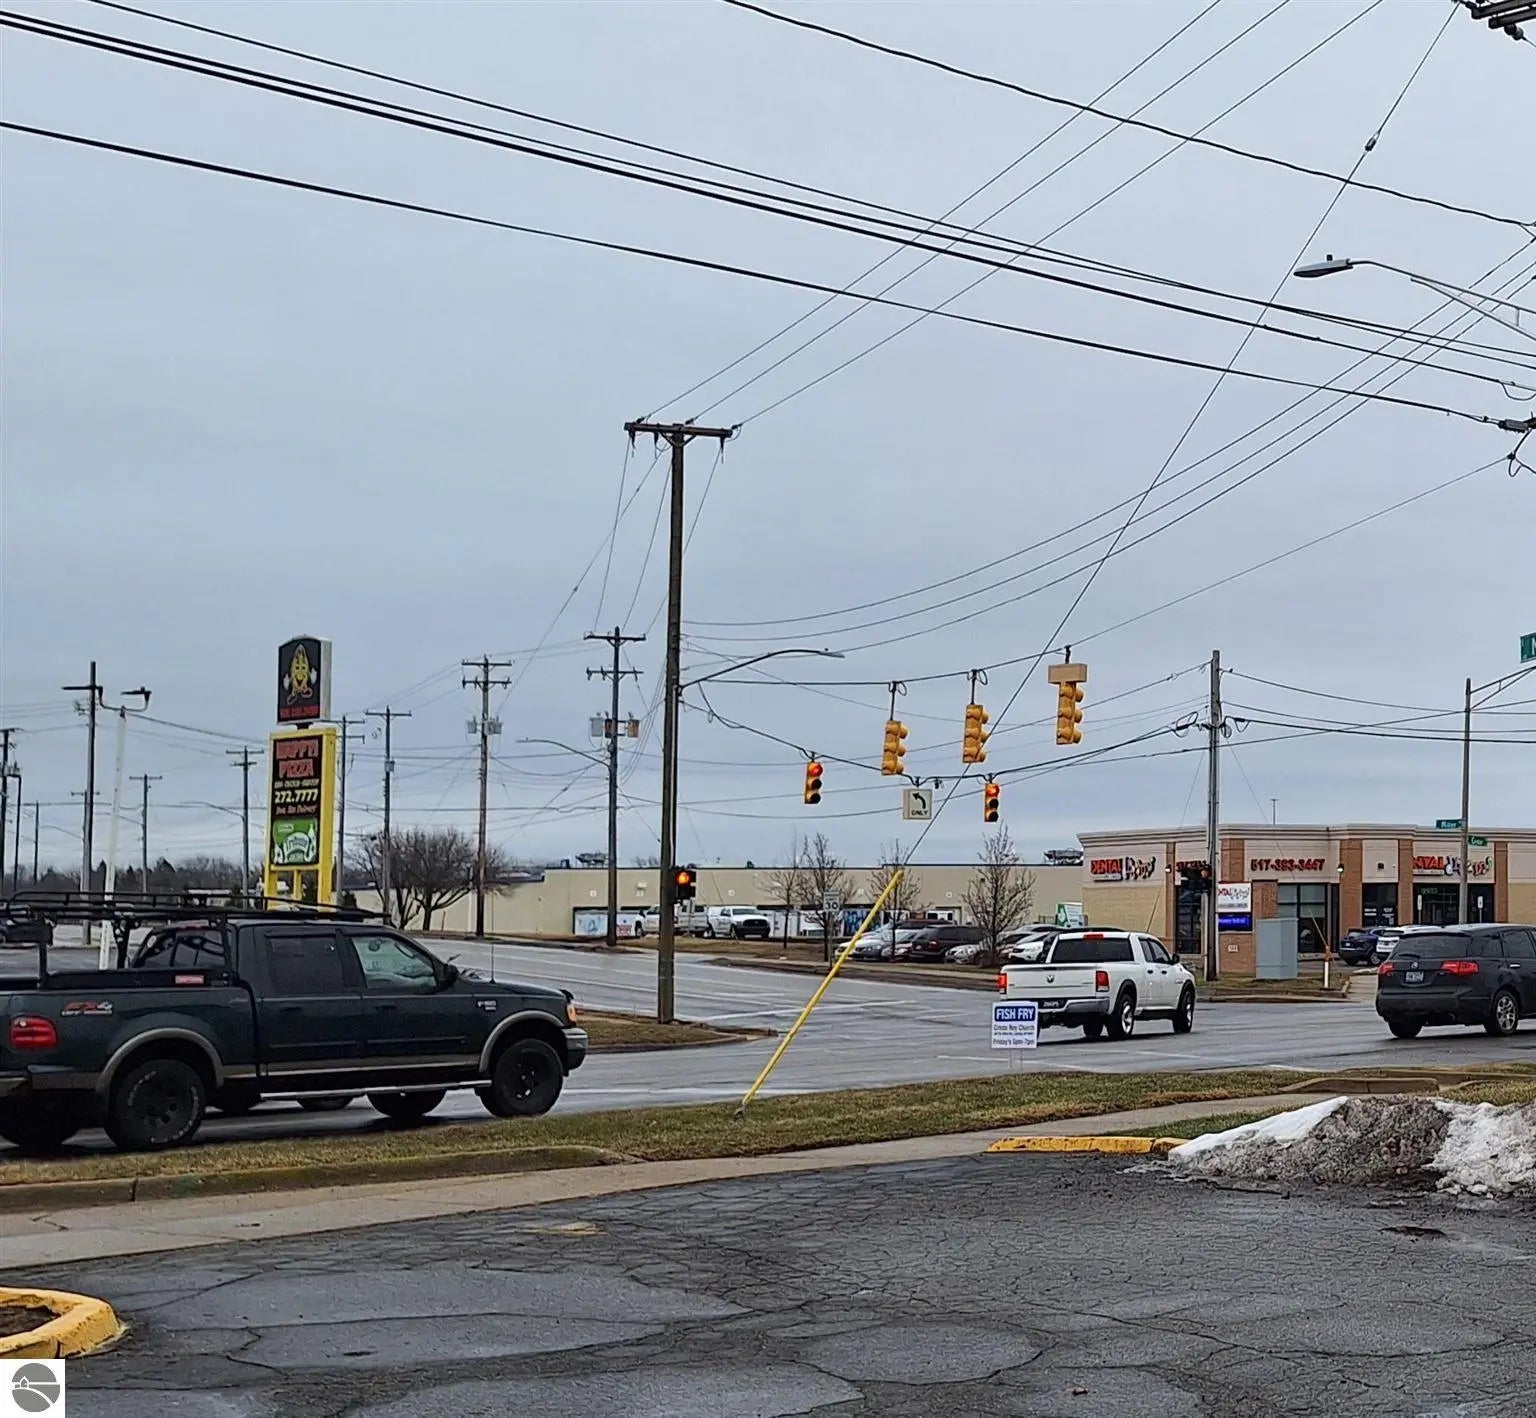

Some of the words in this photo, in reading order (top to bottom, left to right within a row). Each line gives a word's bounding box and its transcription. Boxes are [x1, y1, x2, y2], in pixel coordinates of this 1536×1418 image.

[1412, 856, 1444, 869] NTAL
[825, 902, 839, 910] 30
[996, 1008, 1016, 1020] FISH
[1017, 1007, 1034, 1020] FRY
